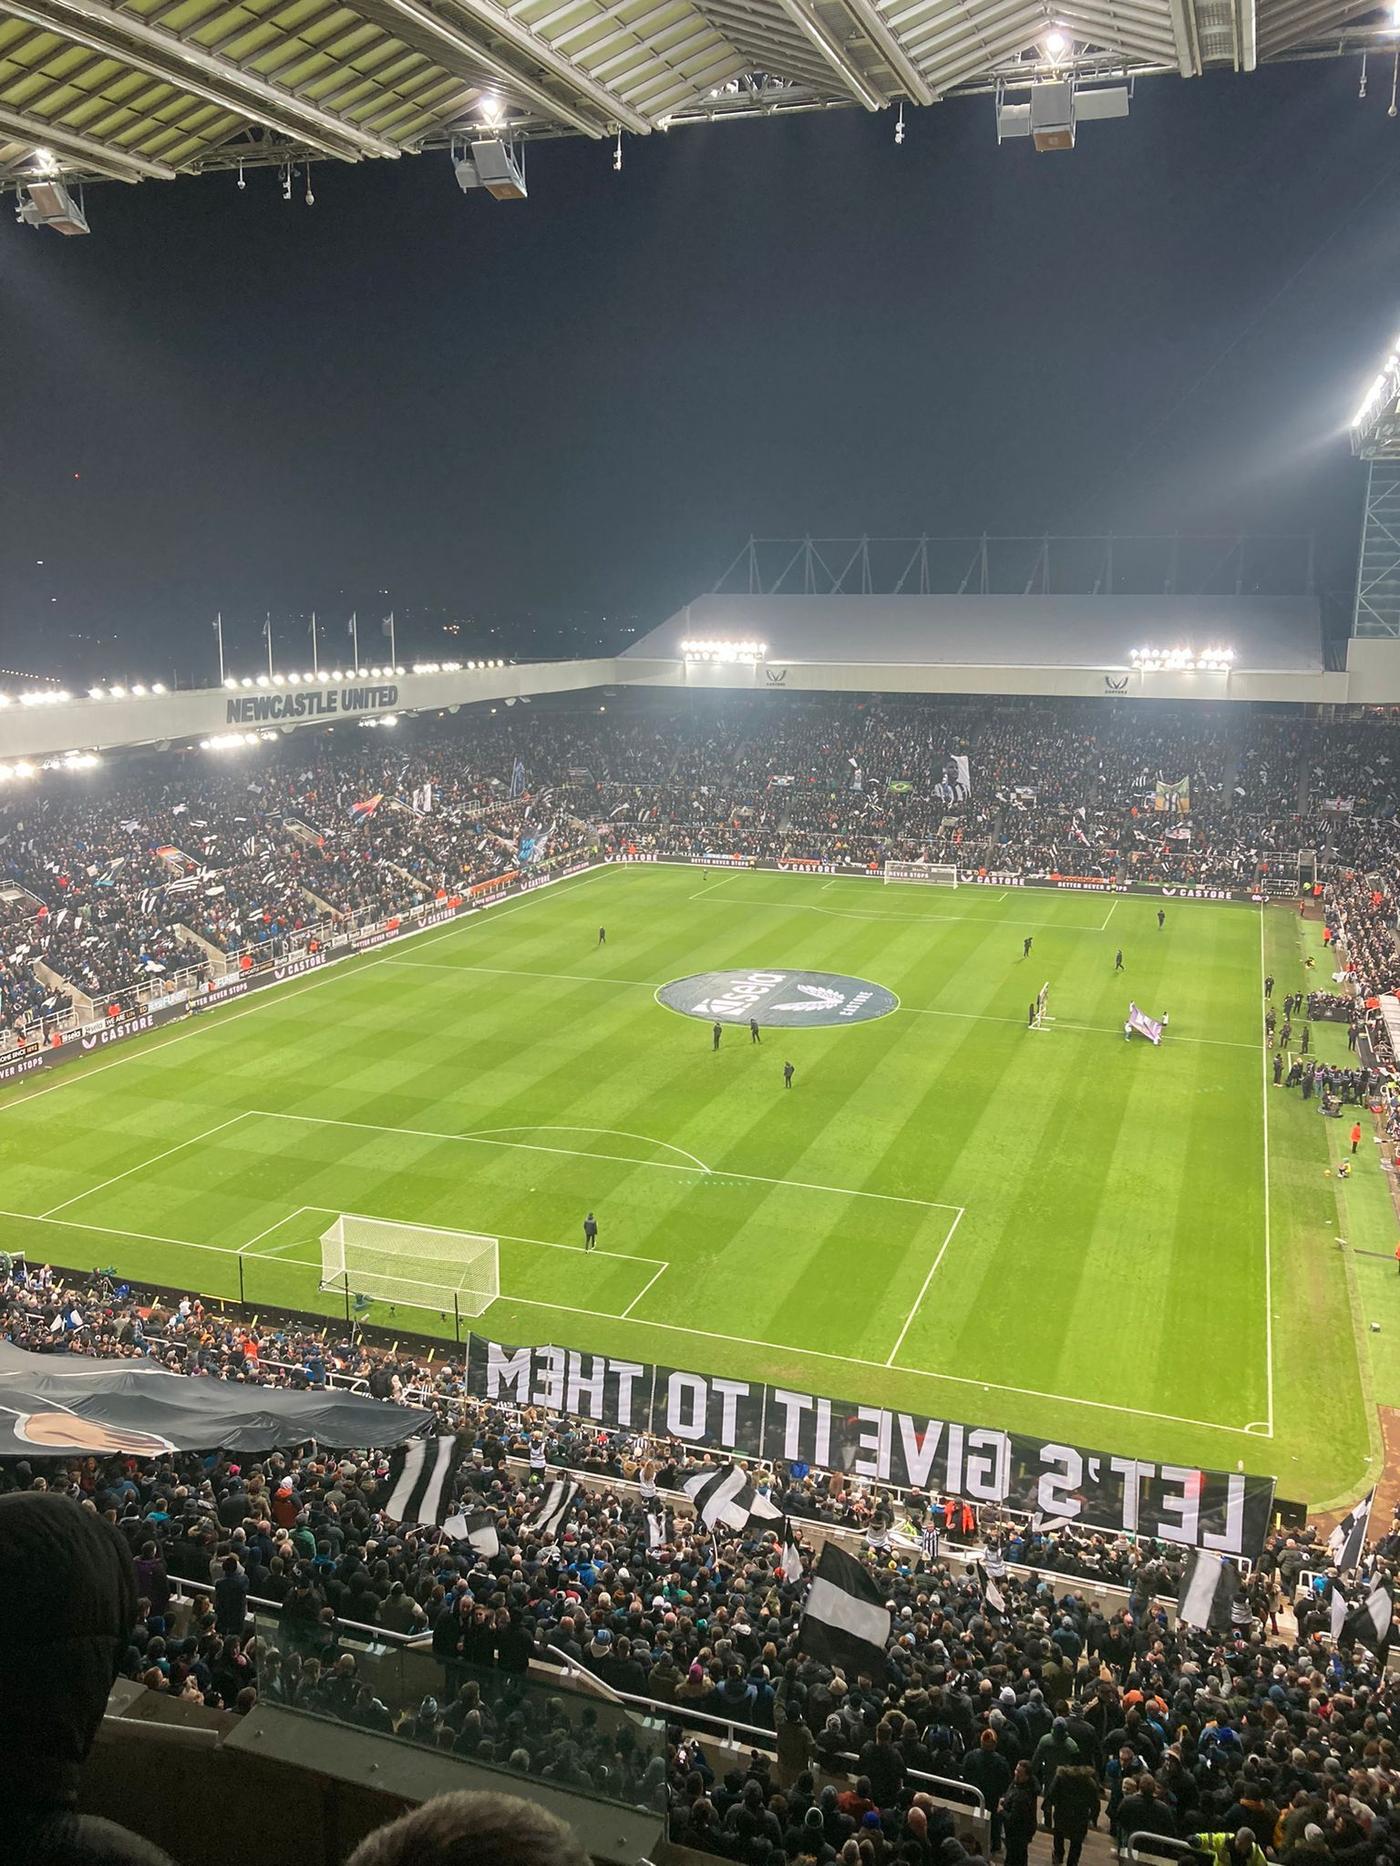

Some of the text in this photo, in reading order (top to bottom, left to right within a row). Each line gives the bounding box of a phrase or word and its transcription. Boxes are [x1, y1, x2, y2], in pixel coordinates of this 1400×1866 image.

[226, 685, 398, 724] NEWCASTLE UNITED
[615, 853, 658, 862] CASTORE
[792, 863, 836, 873] CASTORE
[977, 876, 1024, 886] CASTORE
[1179, 889, 1232, 900] CASTORE
[427, 908, 456, 925] CASTORE
[287, 953, 327, 975] CASTORE
[721, 972, 786, 1002] sela
[185, 982, 248, 1010] BTER NEVER STOPS
[101, 1015, 154, 1044] CASTORE
[18, 1057, 43, 1072] STOPS
